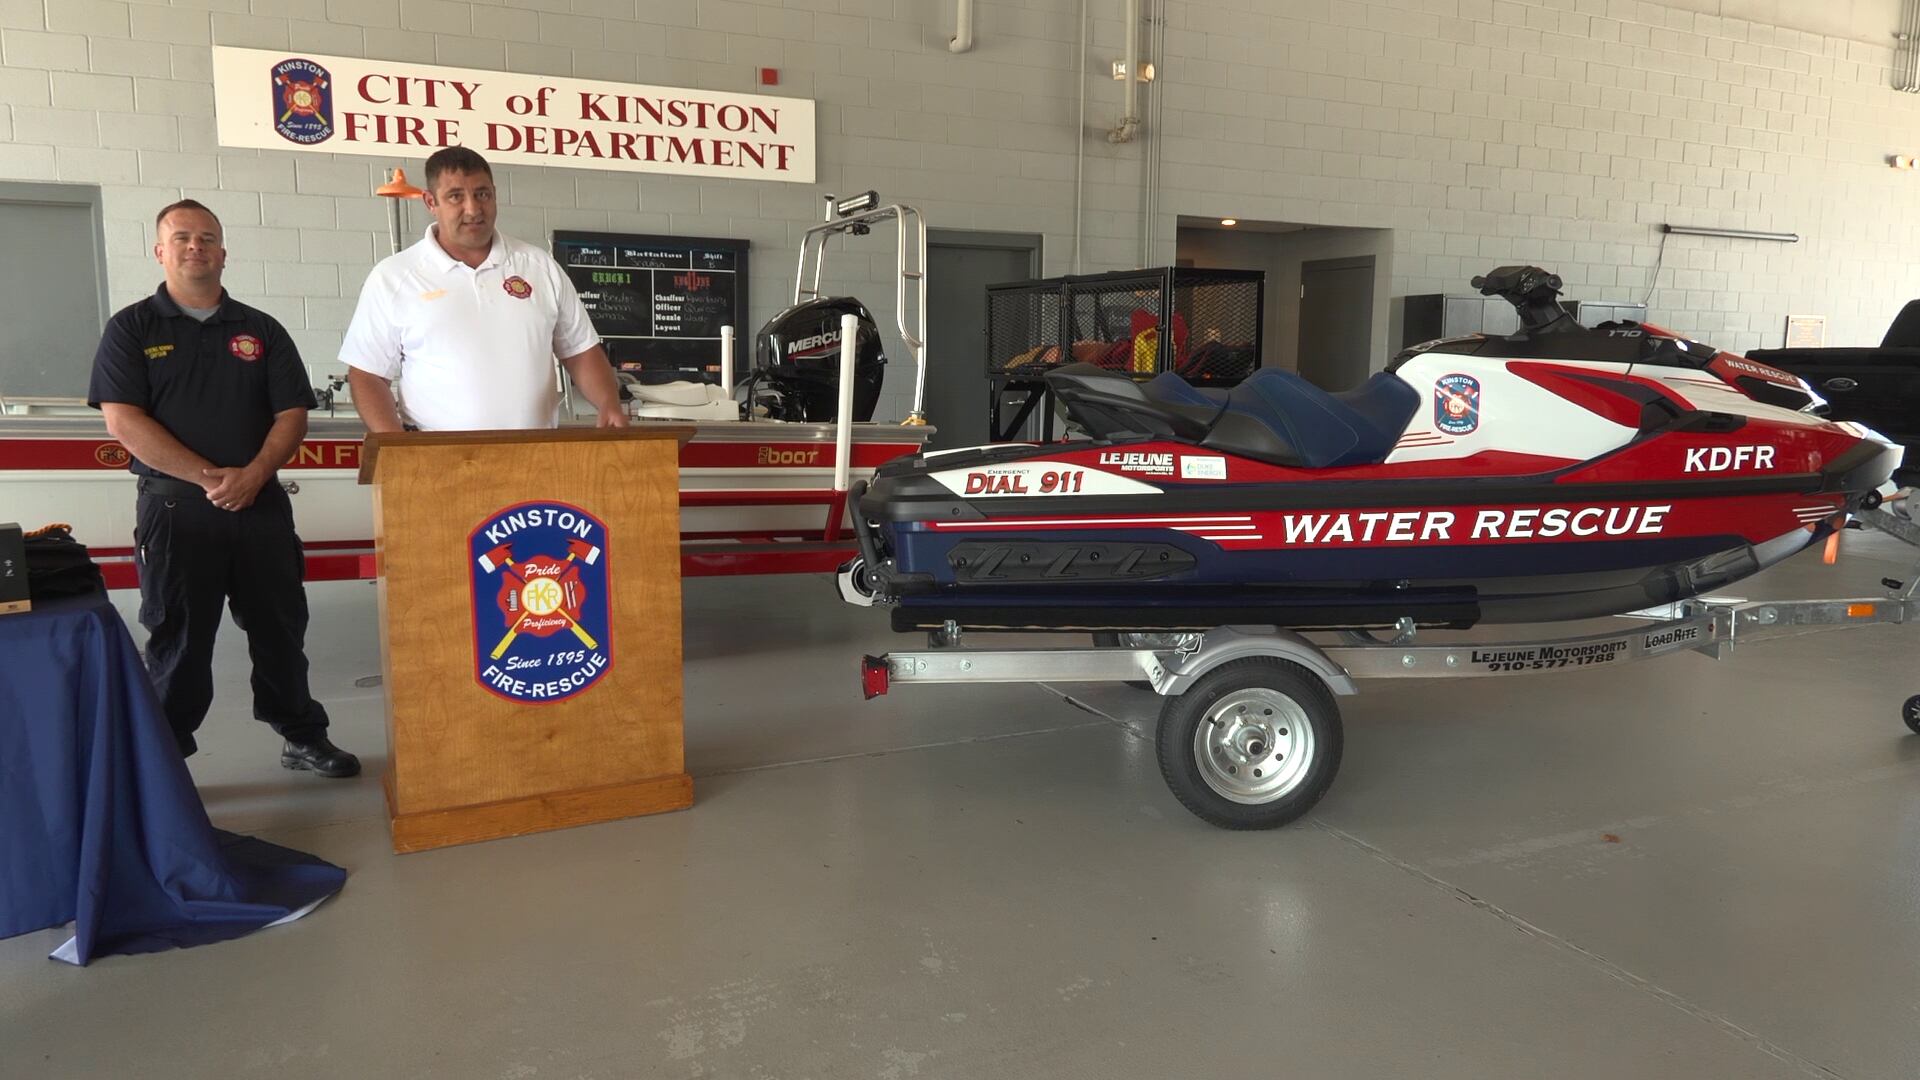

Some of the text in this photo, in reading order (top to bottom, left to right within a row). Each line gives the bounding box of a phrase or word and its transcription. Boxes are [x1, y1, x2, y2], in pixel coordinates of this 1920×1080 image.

[278, 61, 324, 77] KINSTON
[357, 74, 780, 135] CITY of KINSTON
[277, 123, 332, 142] FIRE-RESCUE
[341, 111, 795, 171] FIRE DEPARTMENT
[624, 250, 682, 258] Battalion
[655, 294, 685, 302] Chauffeur
[655, 303, 681, 311] Officer
[655, 313, 681, 321] Nozzle
[655, 324, 681, 332] Layout
[1608, 329, 1642, 338] 170
[788, 329, 842, 353] MERCU
[1725, 359, 1796, 383] WATER RESCUE
[1441, 376, 1473, 385] KINSTON
[1100, 453, 1174, 465] LEJEUNE
[1684, 445, 1776, 472] KDFR
[964, 471, 1084, 494] DIAL 911
[485, 509, 592, 544] KINSTON
[1283, 504, 1671, 544] WATER RESCUE
[524, 563, 560, 577] Pride
[523, 617, 566, 628] Proficiency
[506, 650, 585, 670] Since 1895
[1471, 641, 1627, 663] LEJEUNE MOTORSPORTS
[1488, 653, 1615, 671] 910-577-1788
[482, 652, 606, 697] FIRE-RESCUE
